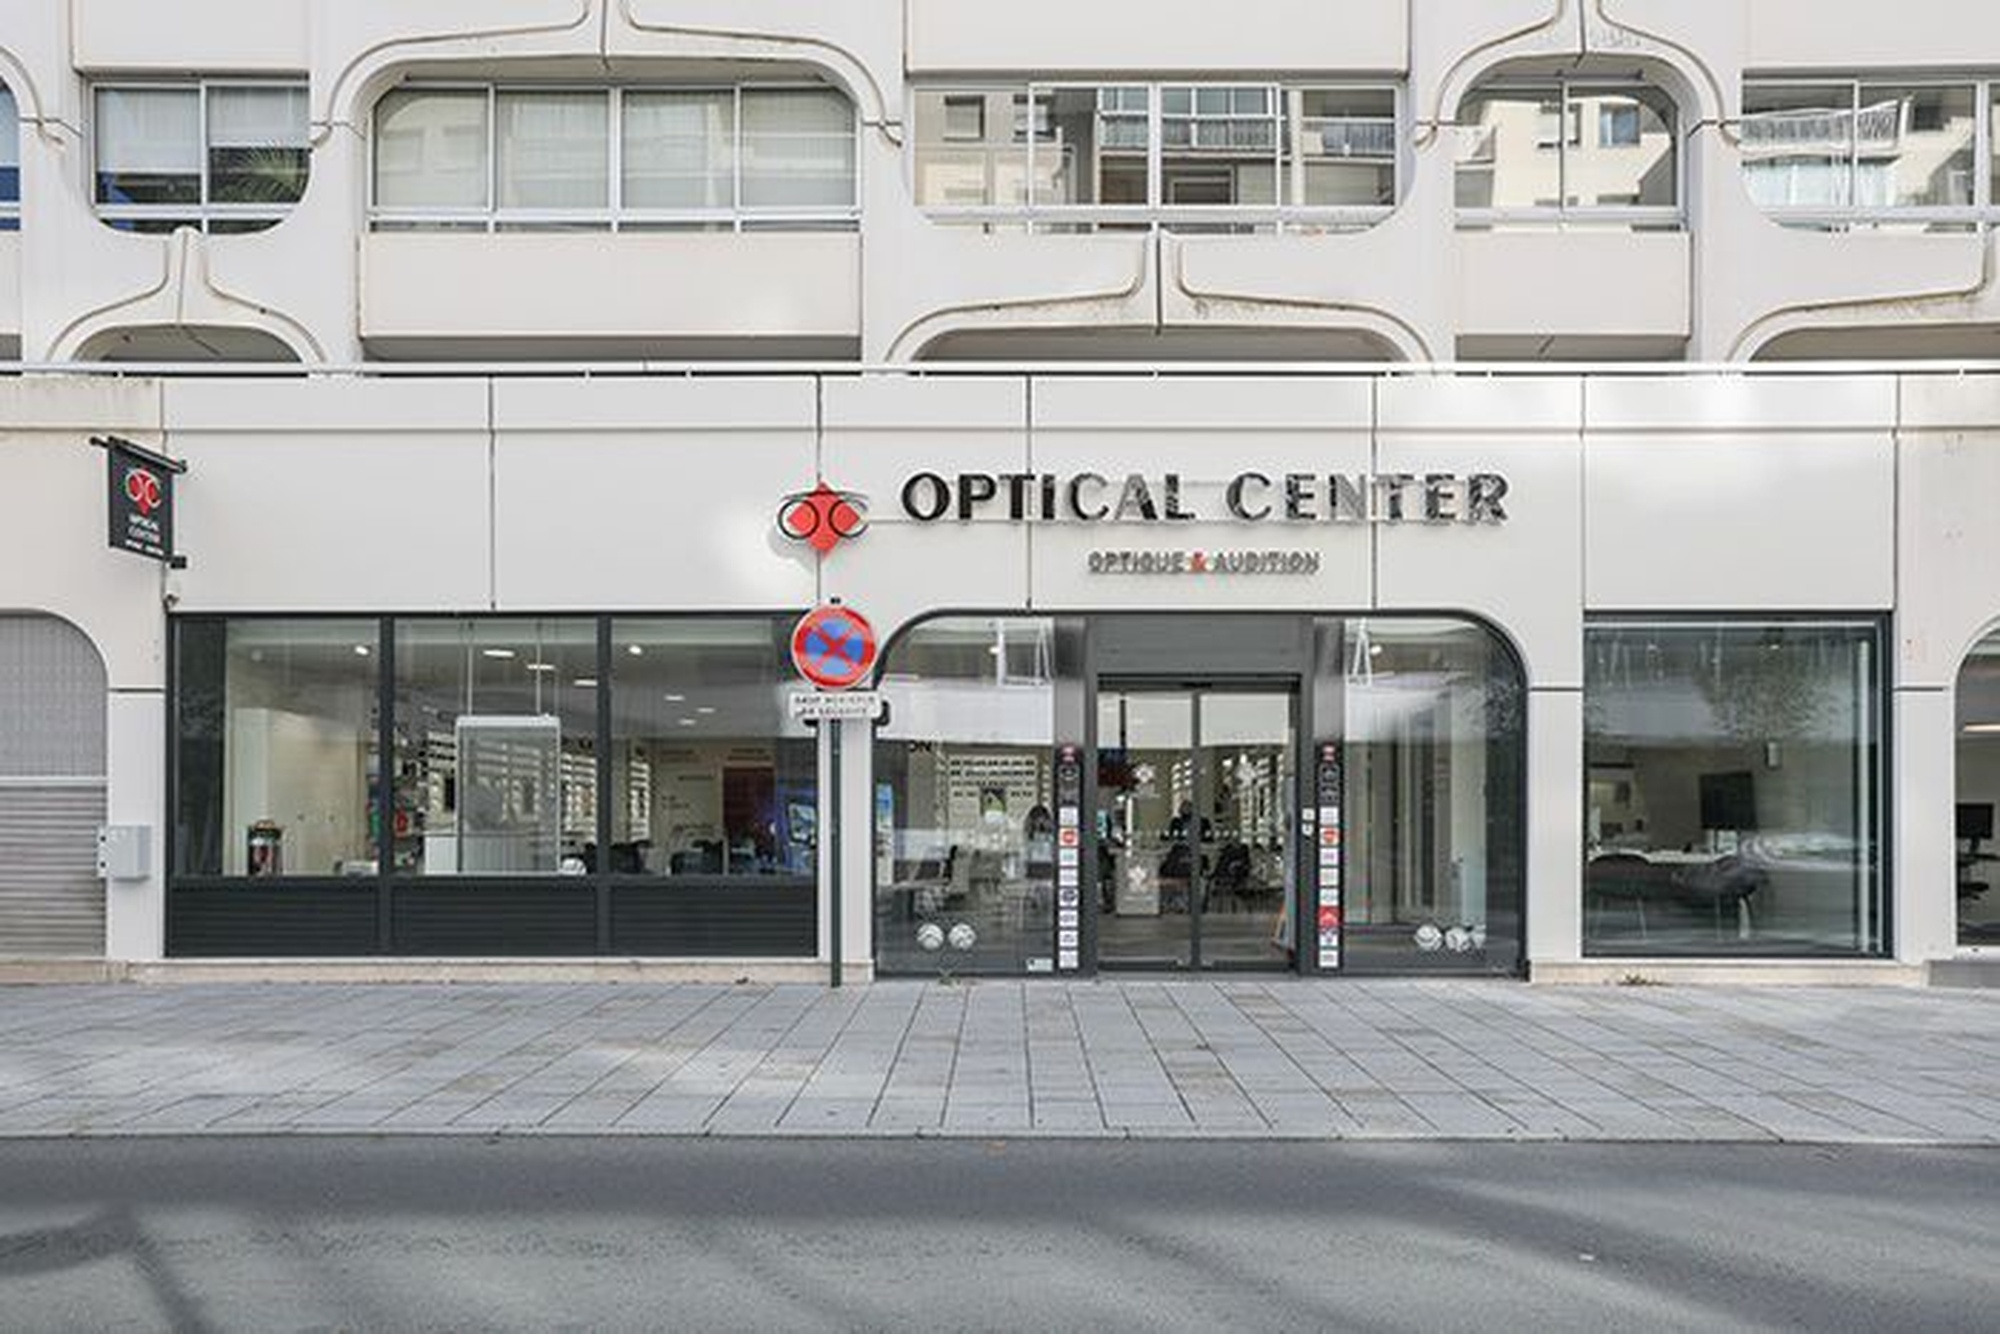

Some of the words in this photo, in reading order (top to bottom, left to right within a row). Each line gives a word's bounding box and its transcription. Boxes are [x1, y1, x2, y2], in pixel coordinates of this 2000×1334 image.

[902, 472, 1195, 521] OPTICAL
[1226, 472, 1508, 521] CENTER
[1088, 550, 1184, 574] OPTIQUE
[1190, 550, 1207, 574] &
[1214, 550, 1319, 574] AUDITION
